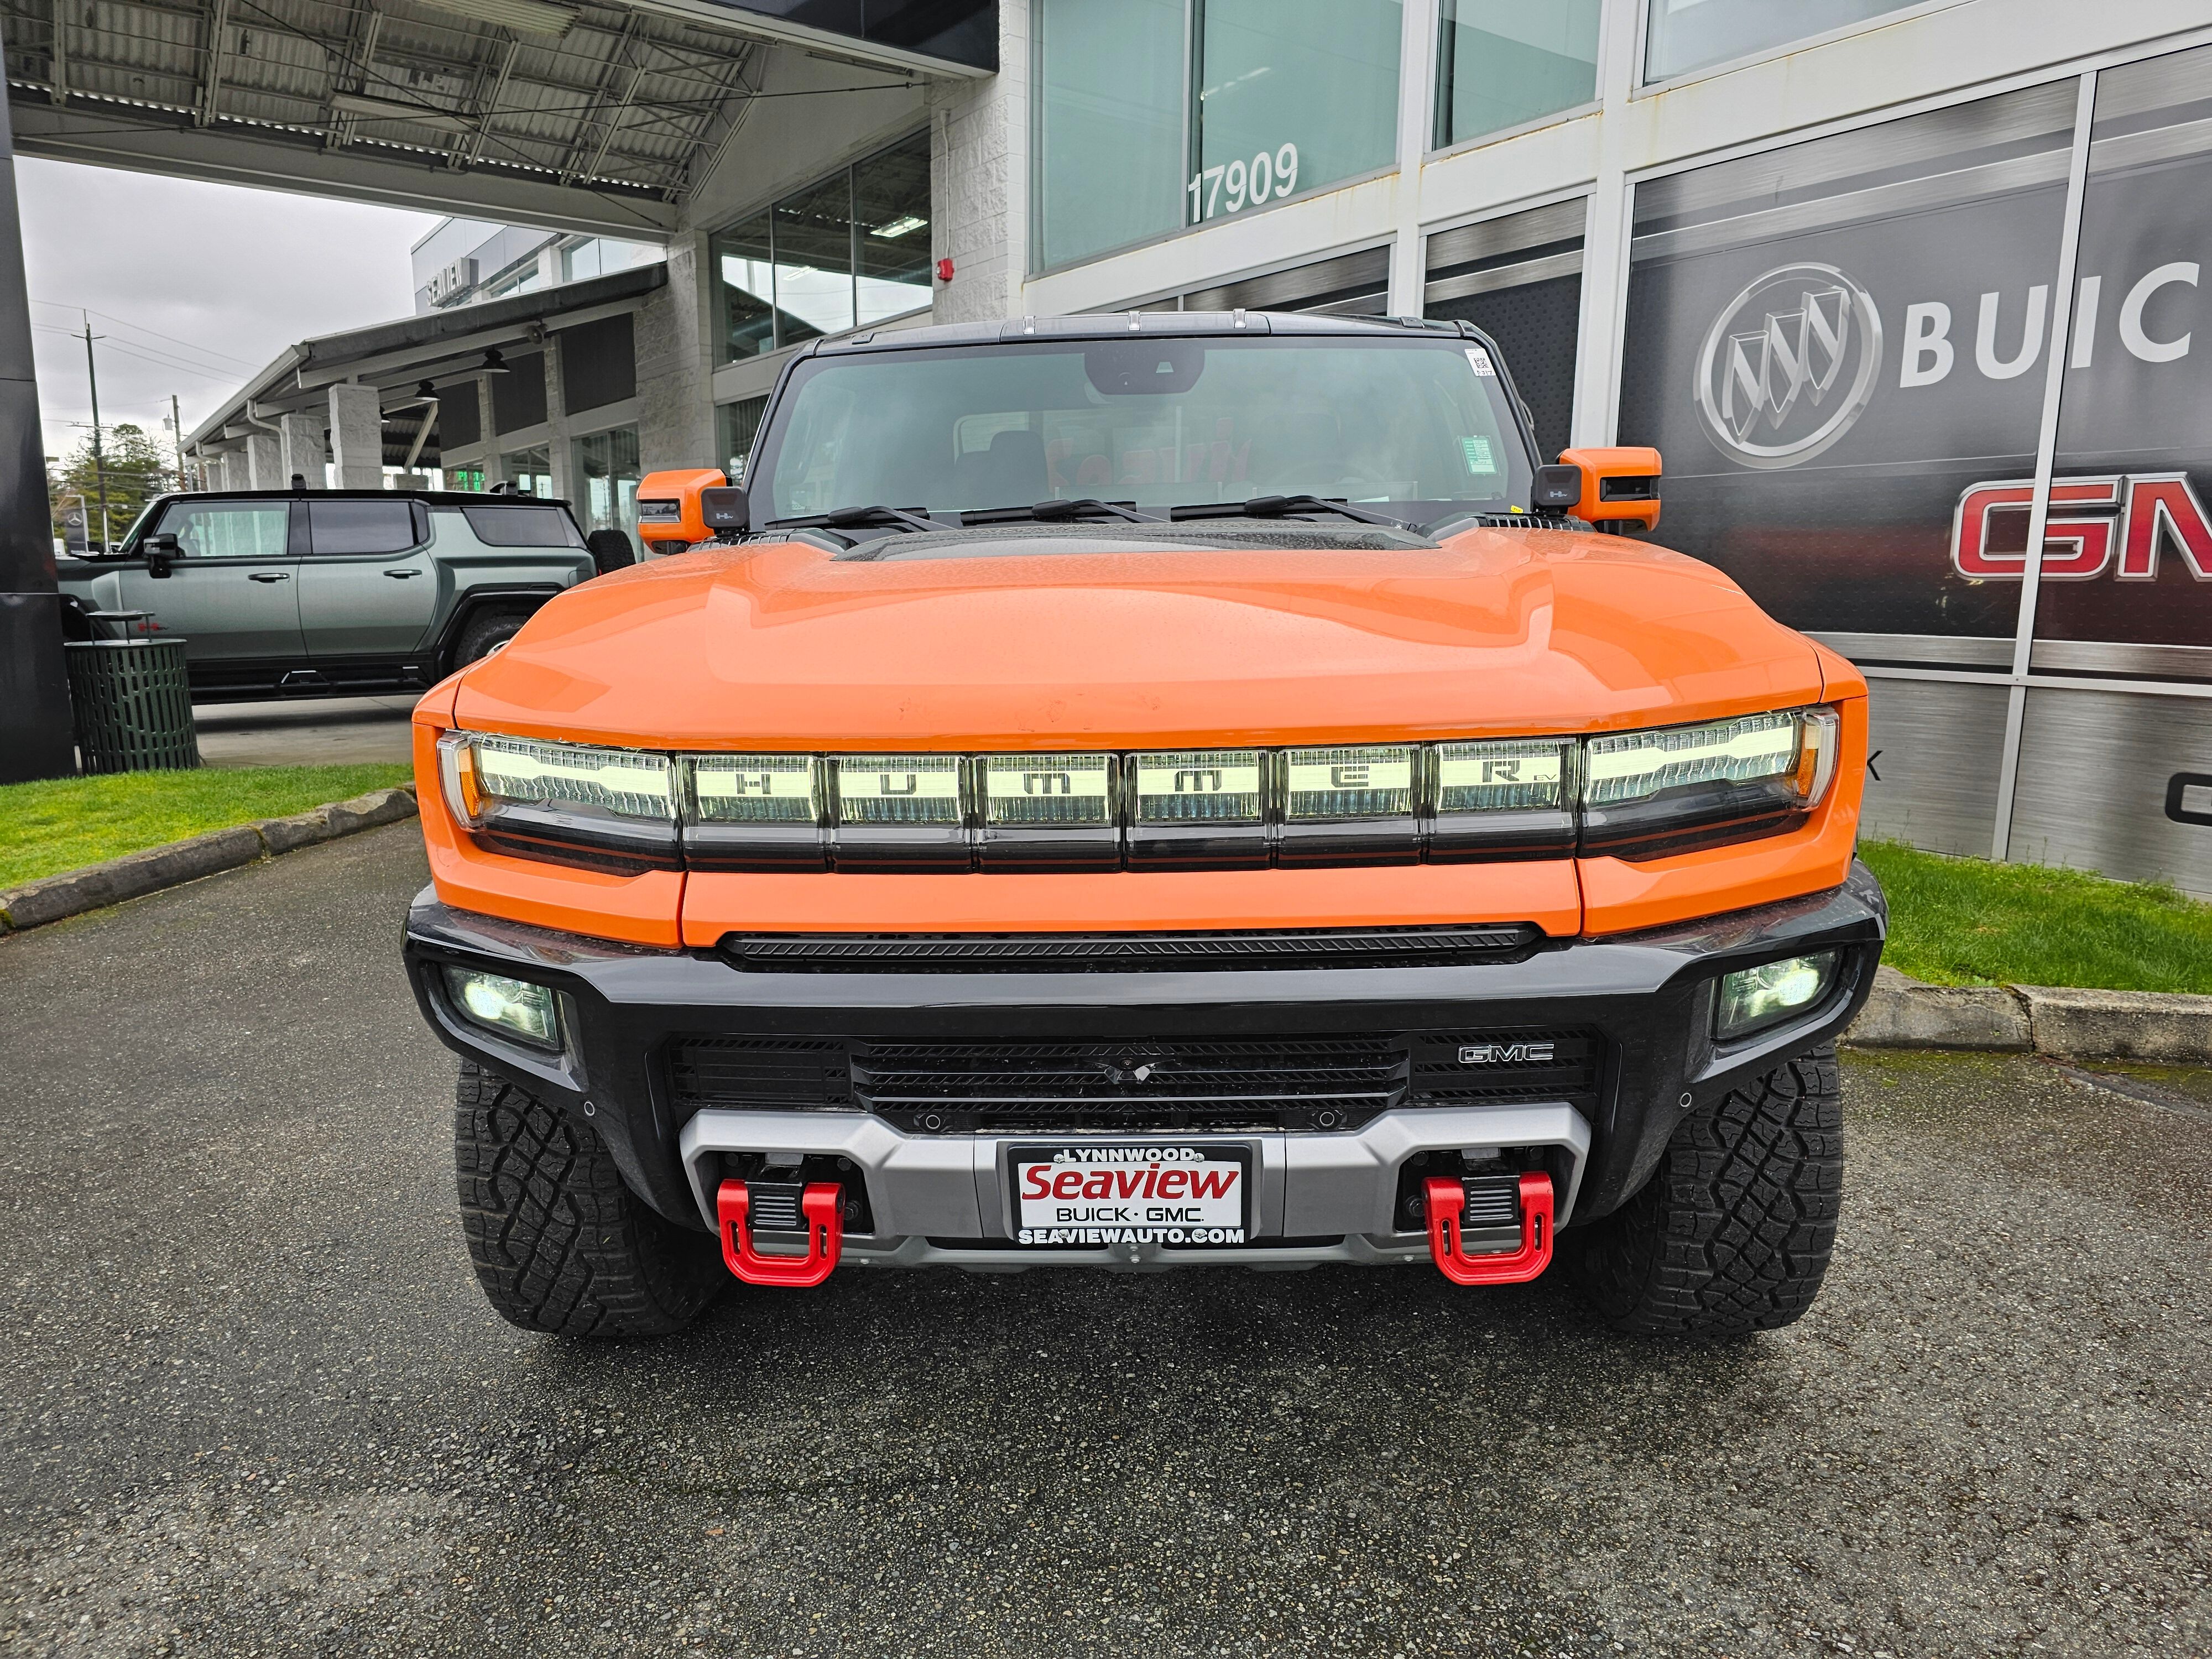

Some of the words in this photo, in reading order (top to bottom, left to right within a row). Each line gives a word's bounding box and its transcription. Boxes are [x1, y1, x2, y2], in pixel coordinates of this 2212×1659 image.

[1188, 143, 1298, 223] 17909
[426, 257, 468, 307] SEAVIEW
[1900, 262, 2200, 388] BUIC
[736, 760, 1520, 795] HUMMER
[1458, 1044, 1554, 1063] GMC
[1063, 1148, 1196, 1162] LYNNWOOD
[1021, 1163, 1239, 1200] Seaview
[1057, 1208, 1132, 1222] BUICK
[1018, 1228, 1244, 1244] SEAVIEWAUTO.COM
